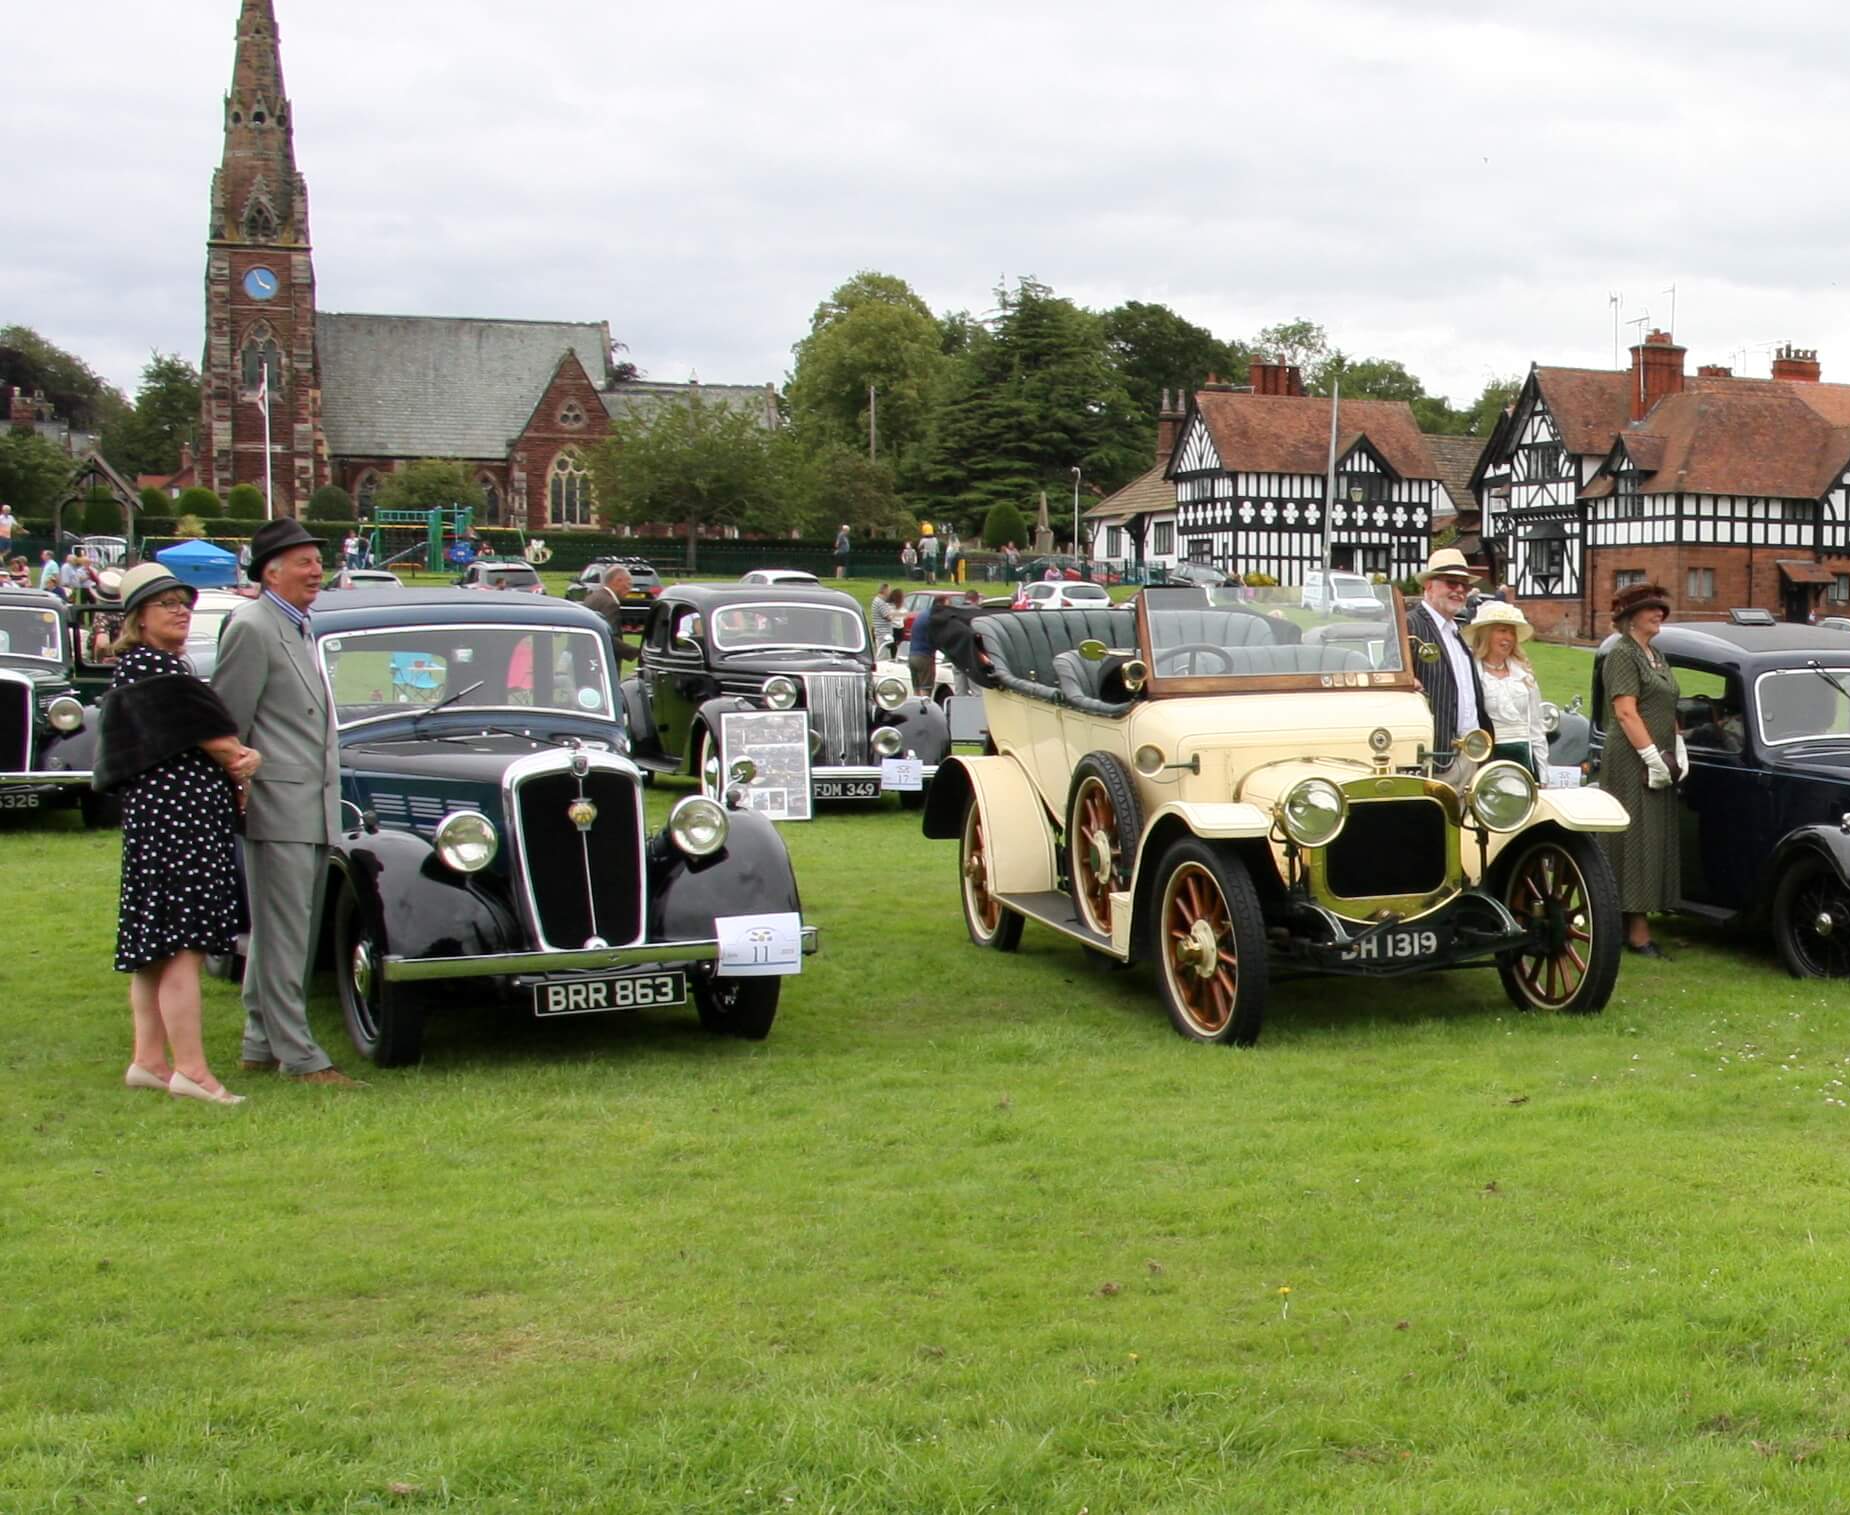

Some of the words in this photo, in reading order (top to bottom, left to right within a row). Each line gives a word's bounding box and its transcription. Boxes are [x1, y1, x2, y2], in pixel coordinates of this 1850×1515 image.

[814, 783, 842, 796] FDM
[846, 783, 875, 796] 349
[753, 945, 768, 962] 11
[1386, 931, 1437, 957] 1319
[548, 983, 604, 1012] BRR
[615, 976, 674, 1005] 863
